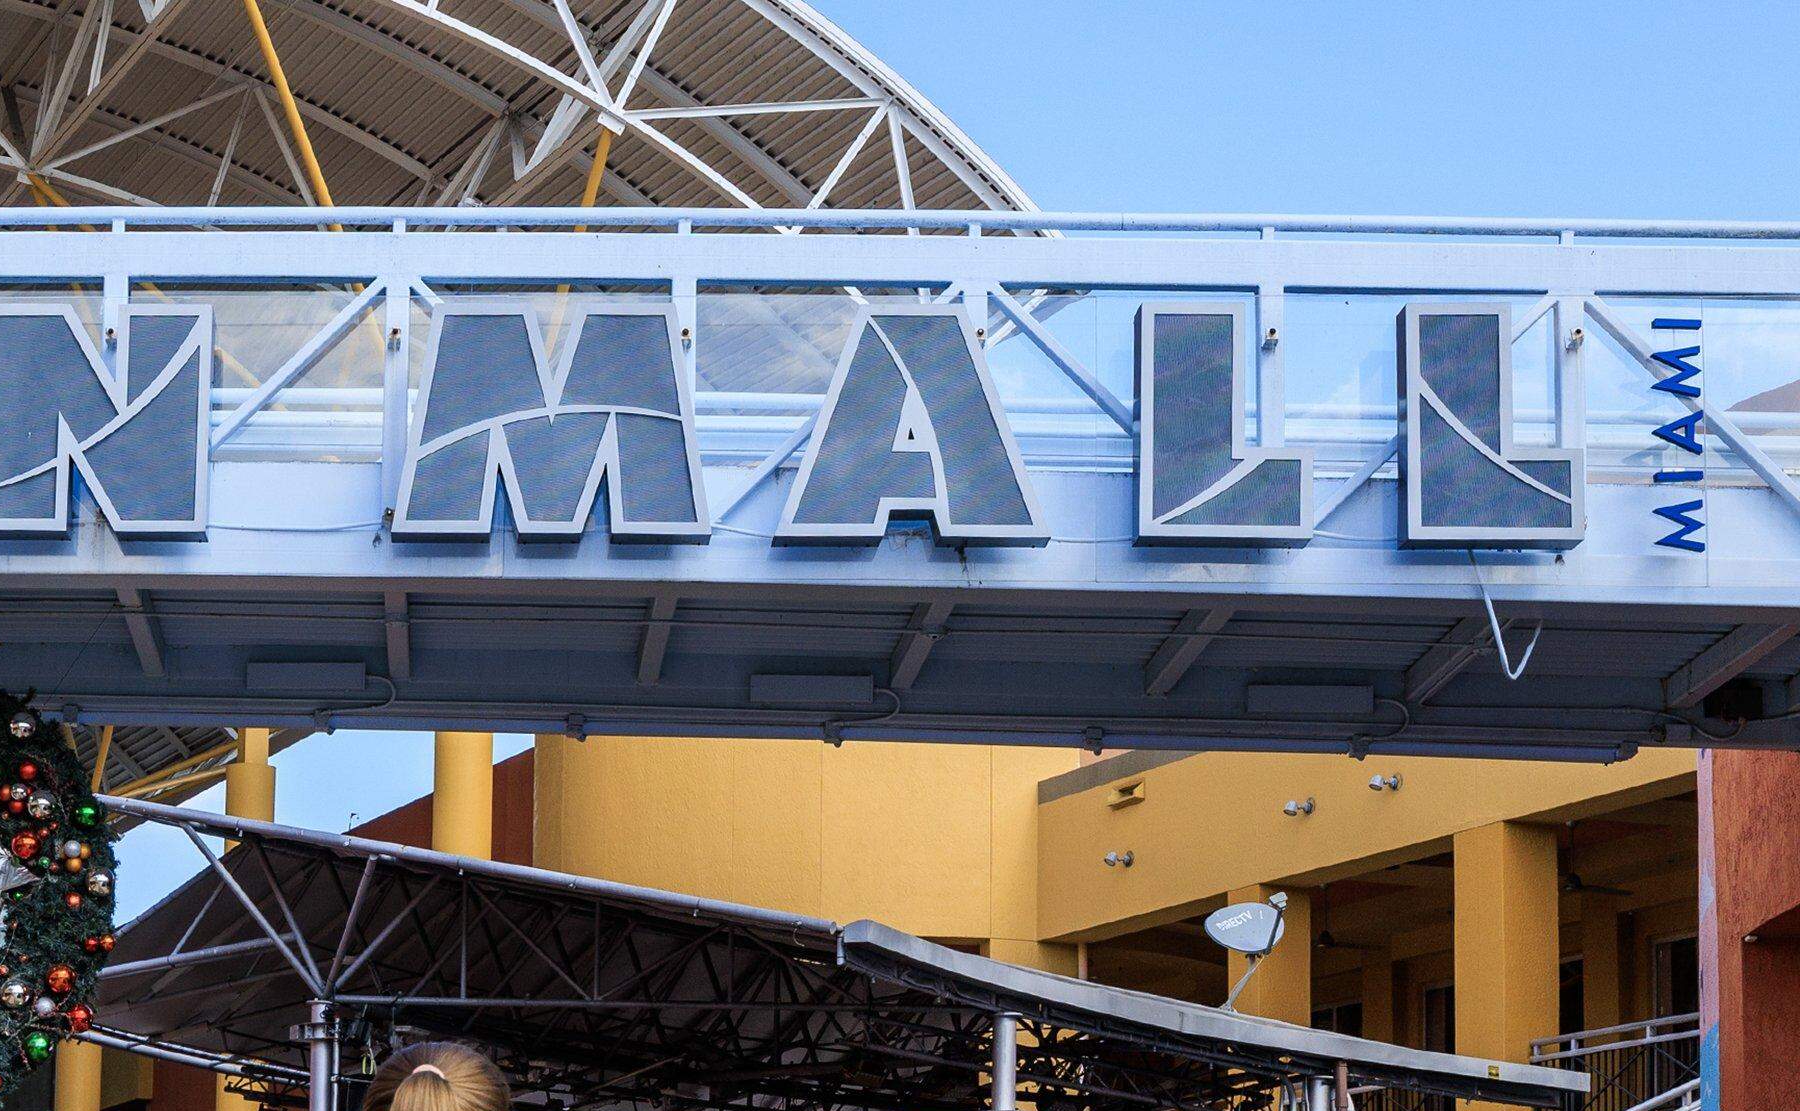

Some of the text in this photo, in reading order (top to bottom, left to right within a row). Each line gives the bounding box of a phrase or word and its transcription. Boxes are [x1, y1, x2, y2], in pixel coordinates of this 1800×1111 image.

[391, 302, 1586, 550] MALL
[1650, 317, 1706, 554] MIAMI
[1215, 909, 1253, 932] DIRECTV
